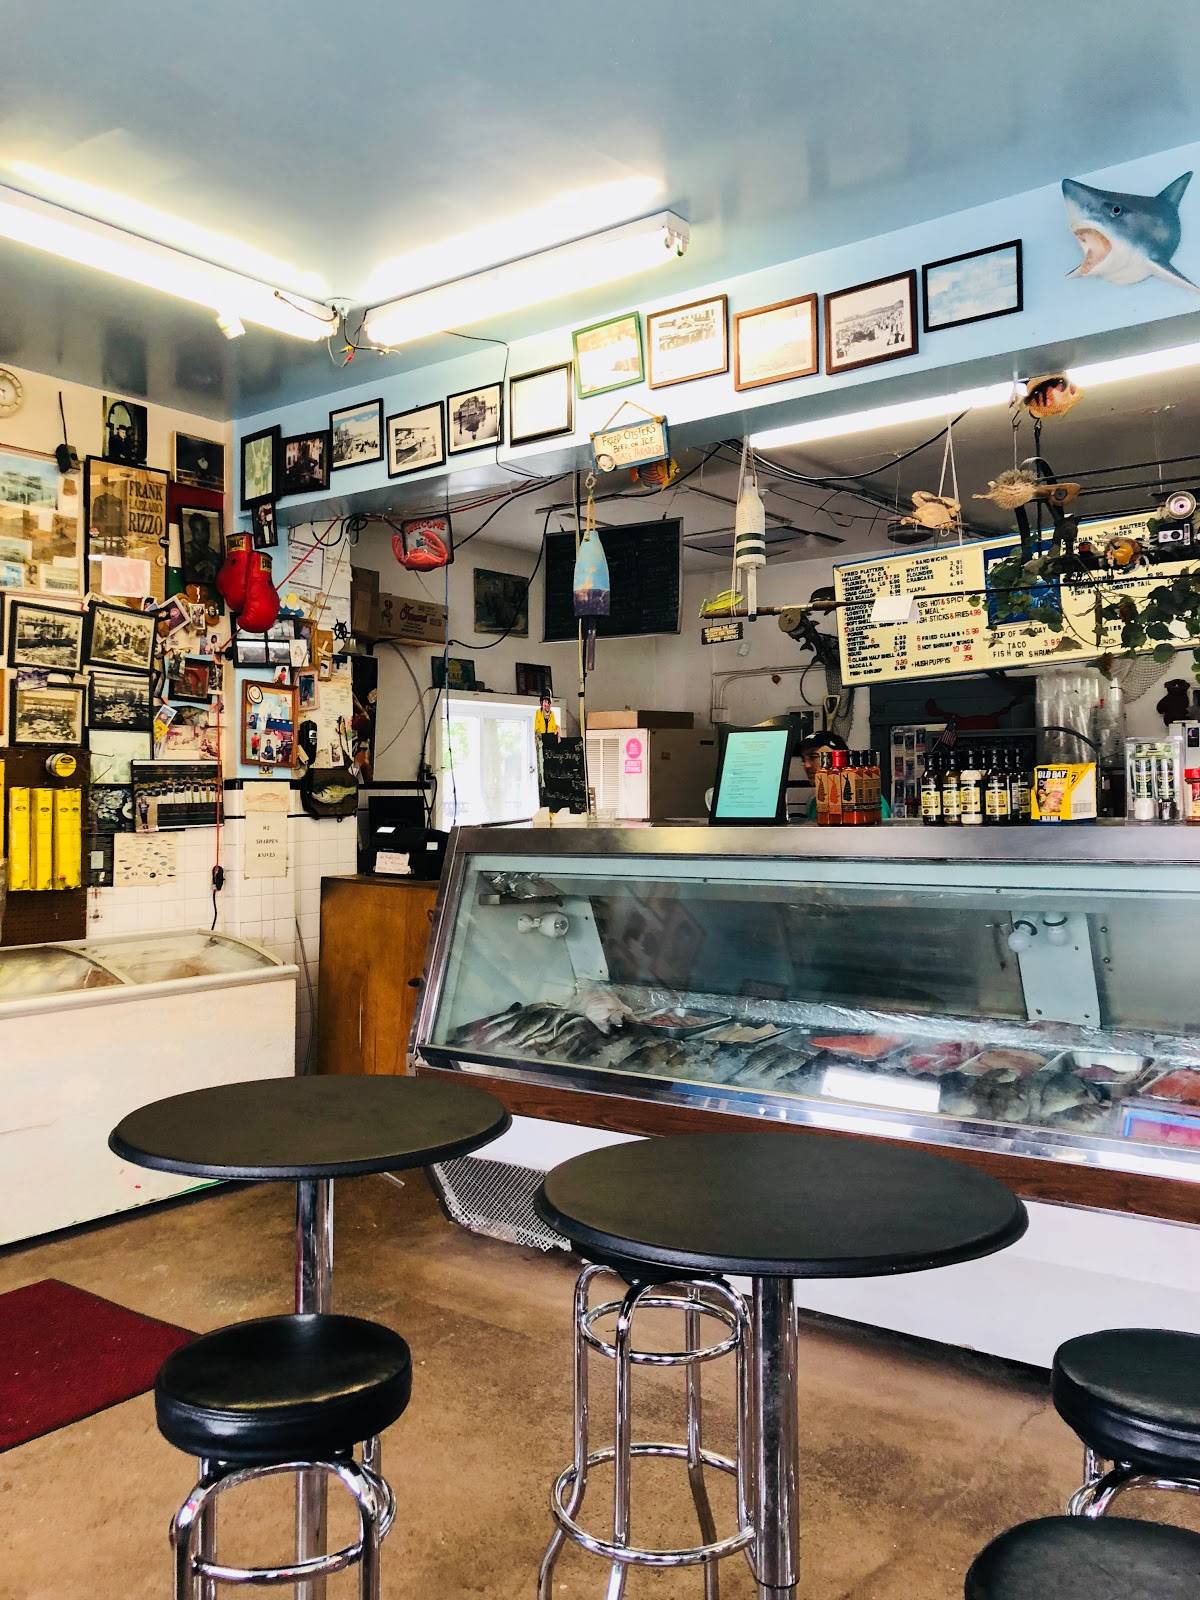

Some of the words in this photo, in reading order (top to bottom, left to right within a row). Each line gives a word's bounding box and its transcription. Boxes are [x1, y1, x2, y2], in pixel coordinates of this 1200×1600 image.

[129, 480, 163, 501] FRANK
[128, 511, 163, 535] RIZZO
[406, 520, 446, 534] WELCOME
[946, 596, 964, 605] SPICY
[929, 614, 949, 622] STICKS
[1008, 630, 1016, 638] OF
[1008, 640, 1027, 649] TACO
[992, 650, 1012, 658] FISH
[1015, 650, 1024, 658] OR
[1037, 770, 1051, 779] OLD
[1051, 769, 1067, 779] BAY
